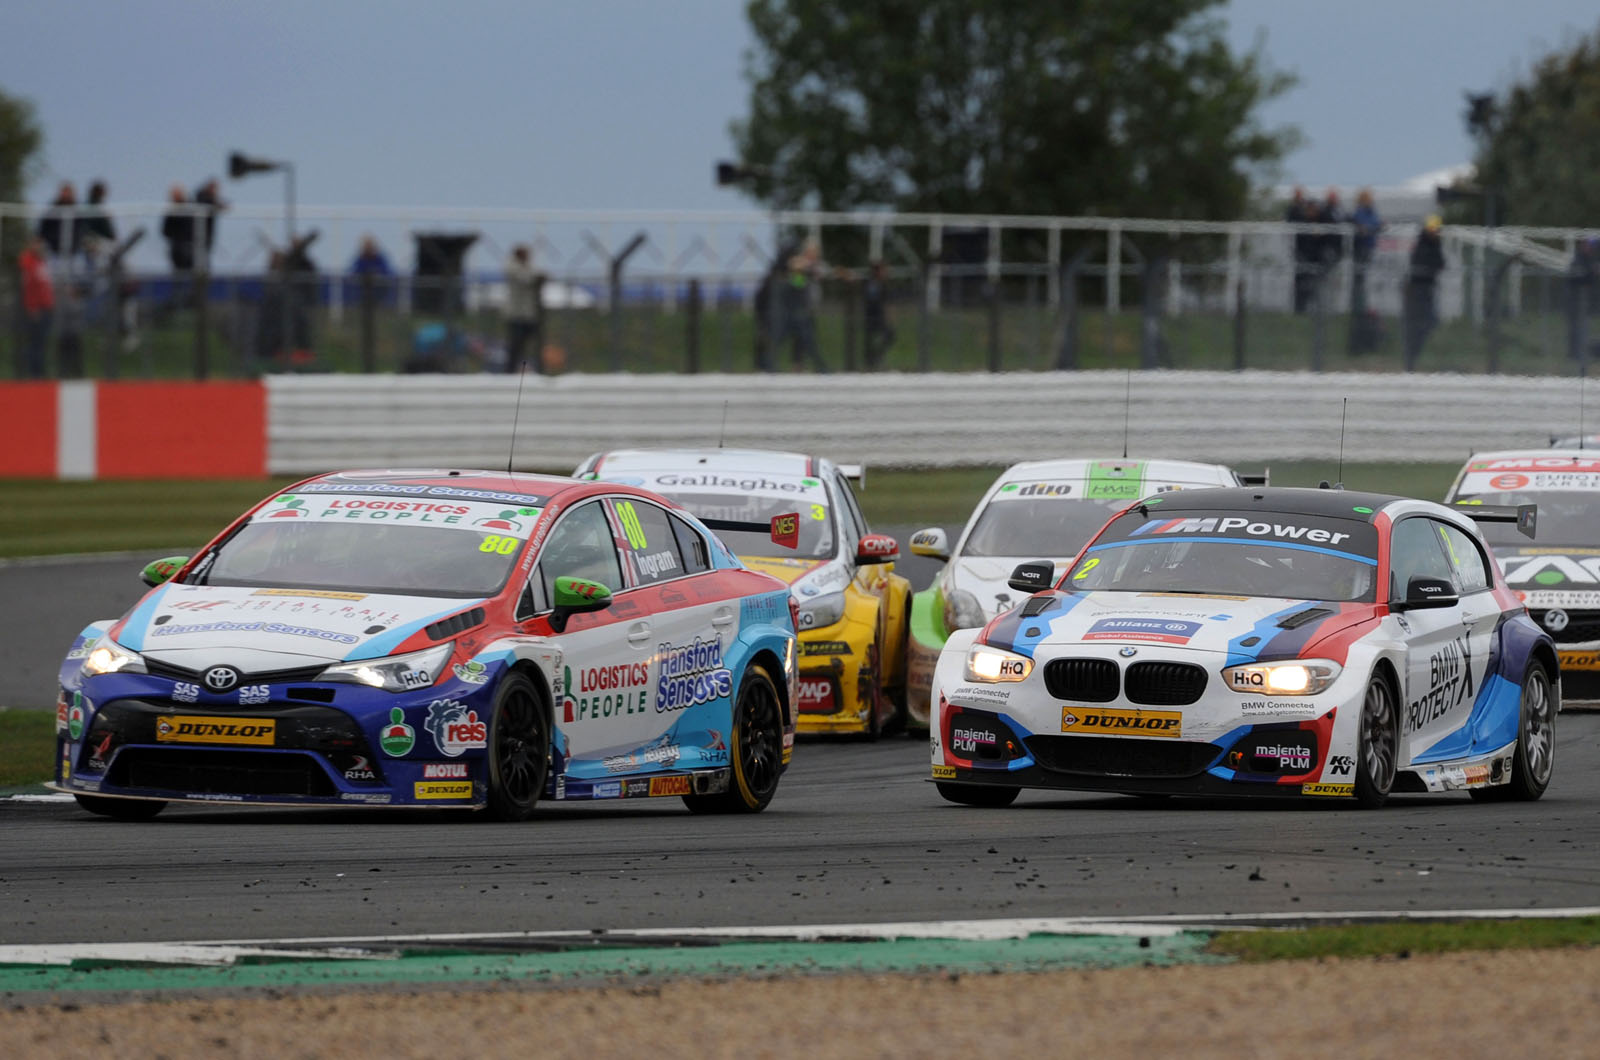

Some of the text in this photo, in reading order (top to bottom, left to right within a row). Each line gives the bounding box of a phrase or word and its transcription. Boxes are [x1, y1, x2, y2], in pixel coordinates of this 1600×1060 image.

[655, 475, 811, 494] Gallagher
[301, 483, 539, 503] Hansford Sensors
[329, 500, 471, 515] LOGISTICS
[810, 504, 825, 521] 3
[320, 509, 463, 524] PEOPLE
[615, 501, 648, 550] 80
[774, 517, 796, 536] NES
[478, 535, 519, 555] 80
[634, 549, 677, 578] Ingram
[1073, 558, 1100, 580] 2
[242, 601, 400, 620] TOTAL RAIL
[799, 614, 813, 626] iQ
[1103, 619, 1162, 629] Allianz
[154, 622, 359, 643] Hansford Sensors
[1119, 632, 1164, 641] Assistance
[660, 634, 722, 676] Hansford
[1000, 661, 1024, 676] HiQ
[1430, 648, 1459, 689] BMW
[1456, 630, 1473, 705] X
[405, 671, 430, 687] HiQ
[580, 663, 648, 693] LOGISTICS
[1234, 672, 1264, 686] HiQ
[174, 682, 200, 697] SAS
[239, 684, 270, 698] SAS
[658, 671, 731, 711] Sensors
[973, 687, 1010, 699] Connected
[579, 691, 647, 720] PEOPLE
[1241, 701, 1314, 710] BMW Connected
[447, 711, 487, 742] reis
[1081, 714, 1180, 730] DUNLOP
[175, 723, 274, 738] DUNLOP
[954, 728, 996, 743] majenta
[952, 740, 977, 752] PLM
[1255, 744, 1311, 758] majenta
[700, 752, 728, 762] RHA
[1280, 758, 1310, 769] PLM
[344, 770, 375, 779] RHA
[424, 764, 467, 778] MOTUL
[426, 785, 470, 794] DUNLOP
